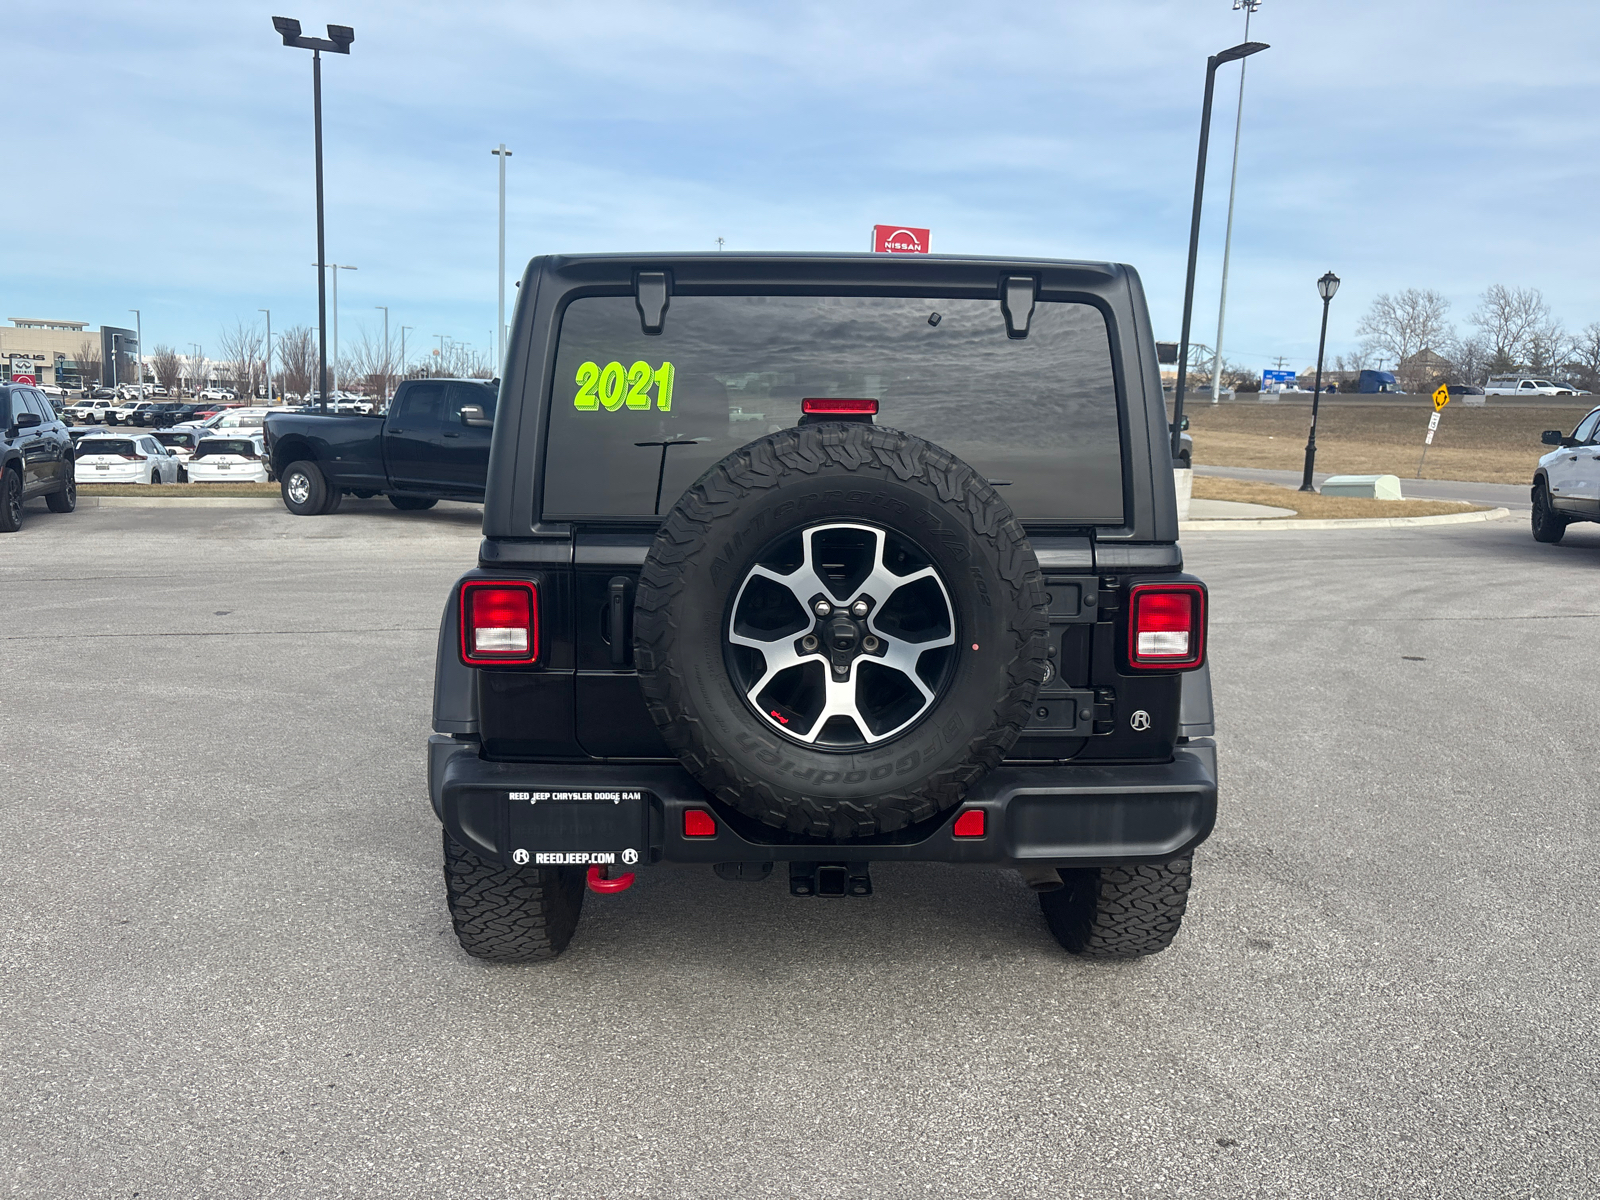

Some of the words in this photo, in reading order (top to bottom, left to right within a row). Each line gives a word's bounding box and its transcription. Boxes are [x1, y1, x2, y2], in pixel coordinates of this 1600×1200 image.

[884, 242, 921, 251] NISSAN
[1, 353, 45, 361] LEXUS
[574, 361, 675, 412] 2021
[710, 489, 911, 588] All-Terrain
[914, 508, 971, 563] T/A
[1130, 710, 1151, 731] R
[735, 712, 964, 784] BFGoodrich
[509, 792, 530, 800] REED
[532, 792, 551, 801] JEEP
[552, 792, 592, 800] CHRYSLER
[594, 792, 620, 801] DODGE
[622, 792, 641, 800] RAM
[535, 852, 615, 864] REEDJEEP.COM
